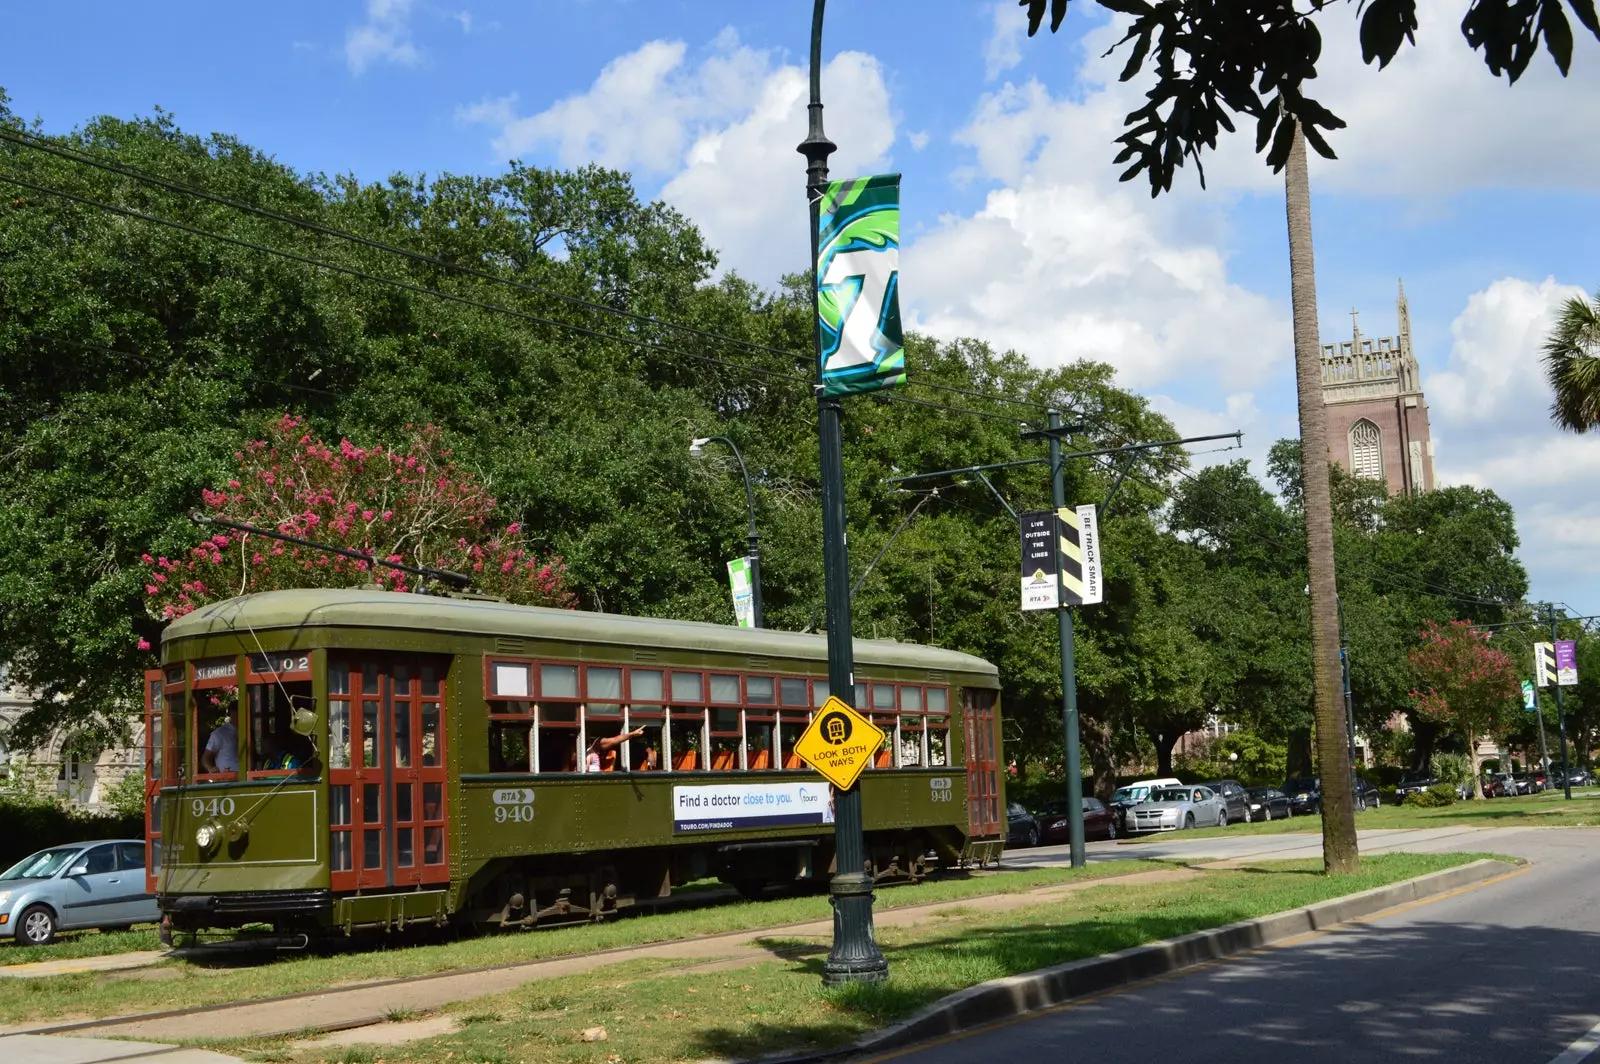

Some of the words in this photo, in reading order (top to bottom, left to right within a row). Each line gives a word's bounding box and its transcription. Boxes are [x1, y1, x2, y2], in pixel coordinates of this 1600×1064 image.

[1084, 517, 1091, 529] BE
[1025, 530, 1050, 538] OUTSIDE
[1085, 532, 1095, 563] TRACK
[1031, 551, 1048, 559] LINES
[1088, 566, 1097, 597] SMART
[813, 750, 838, 761] LOOK
[842, 745, 867, 756] BOTH
[829, 757, 854, 768] WAYS
[501, 792, 516, 801] RTA
[679, 795, 701, 807] Find
[703, 797, 709, 807] a
[711, 794, 740, 806] doctor
[743, 793, 764, 805] close
[765, 793, 775, 804] to
[776, 793, 793, 805] you.
[931, 790, 952, 802] 940
[192, 797, 236, 817] 940
[495, 805, 535, 823] 940
[680, 822, 733, 831] TOURO.COM/FINDADOC
